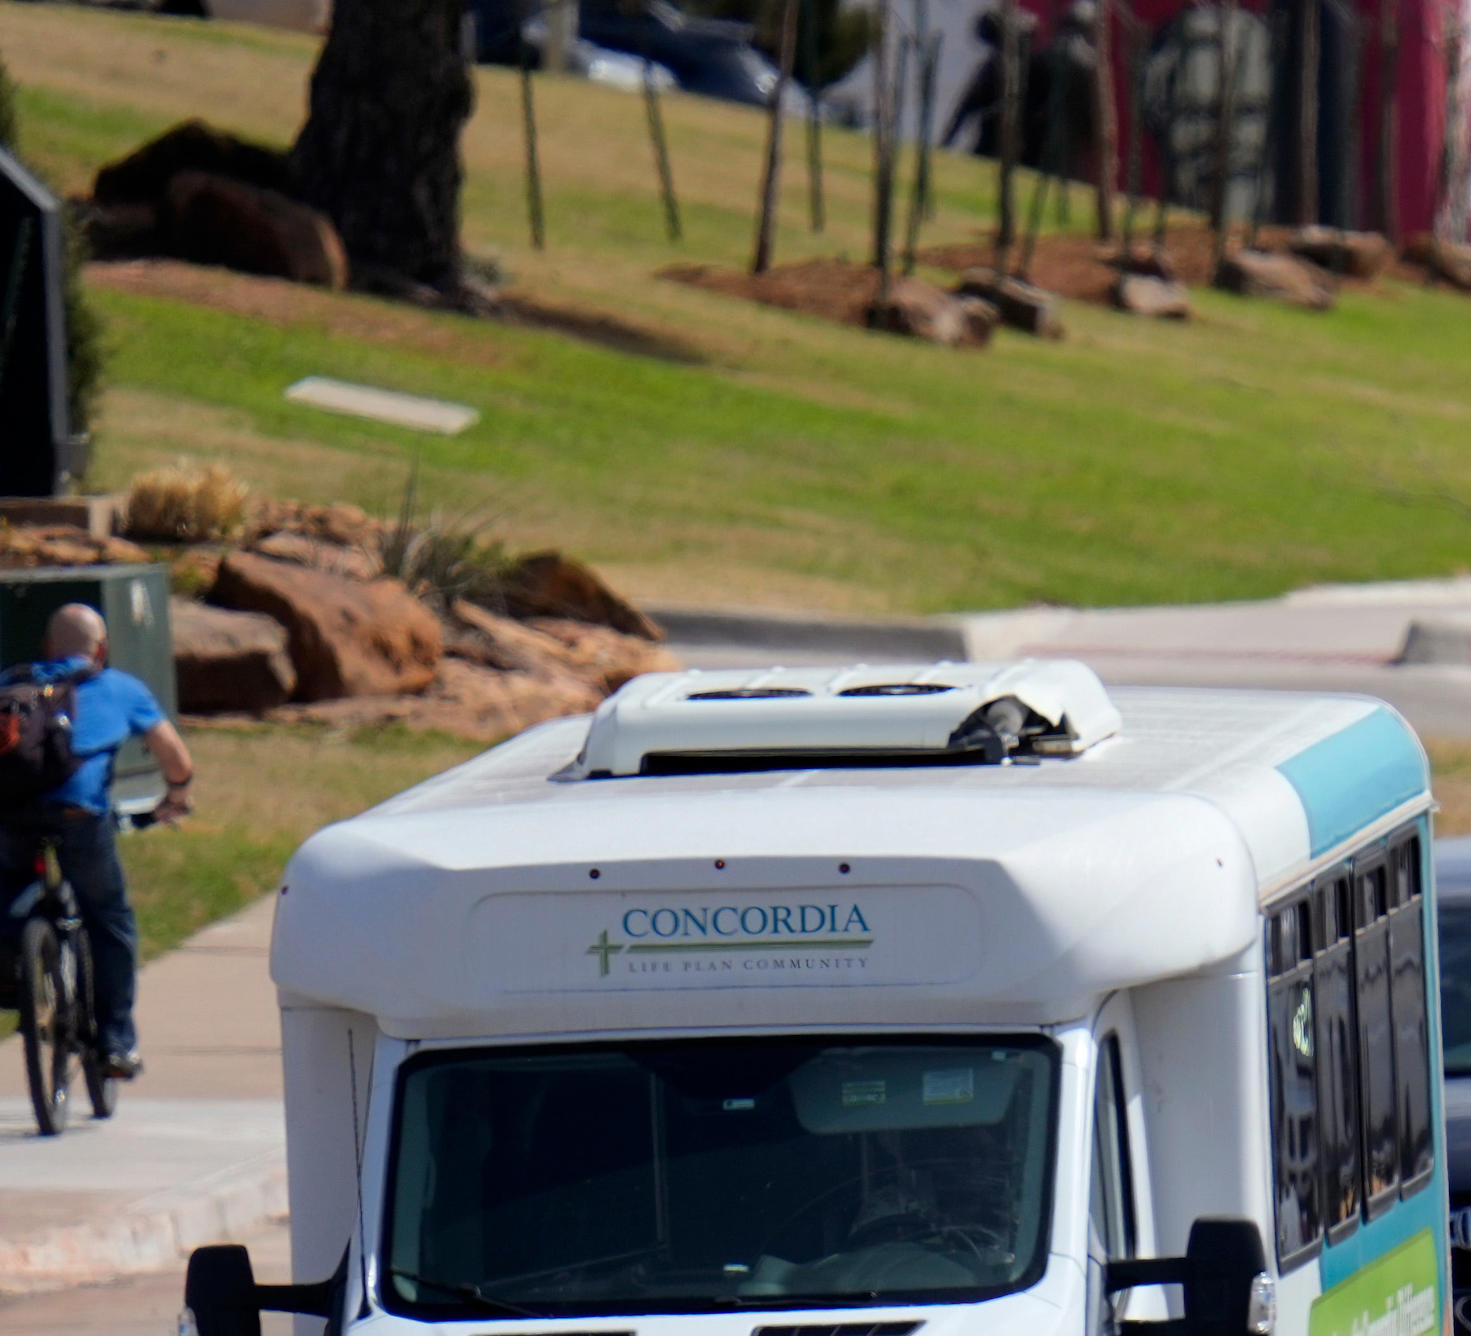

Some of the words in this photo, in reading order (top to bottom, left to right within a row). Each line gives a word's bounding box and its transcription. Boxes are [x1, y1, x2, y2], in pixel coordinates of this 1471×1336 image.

[622, 903, 871, 938] CONCORDIA
[628, 961, 672, 973] LIFE
[683, 960, 733, 972] PLAN
[743, 957, 869, 970] COMMUNITY
